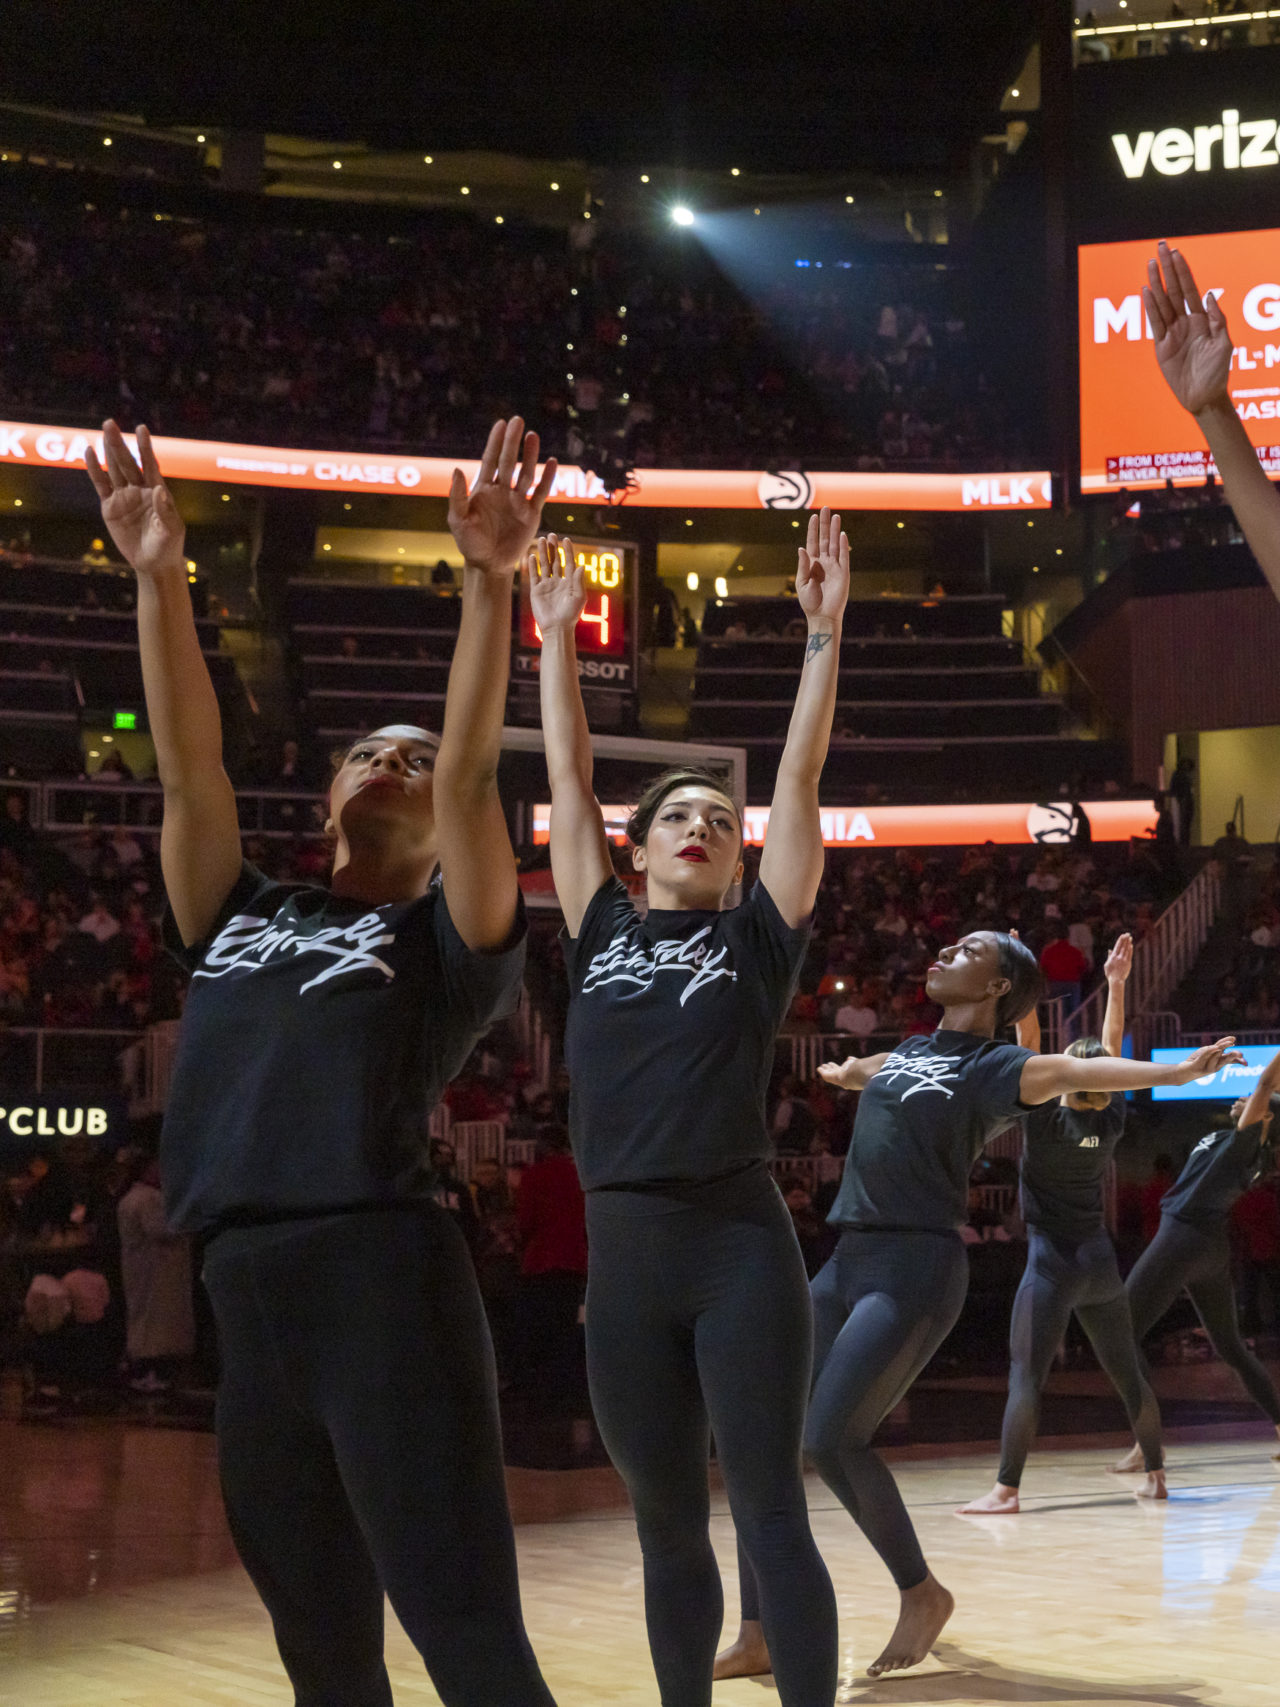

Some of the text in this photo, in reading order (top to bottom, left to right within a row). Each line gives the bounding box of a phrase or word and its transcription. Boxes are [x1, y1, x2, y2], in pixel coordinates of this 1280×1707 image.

[1119, 455, 1152, 468] FROM
[314, 462, 396, 484] CHASE
[1119, 467, 1157, 481] NEVER
[1160, 464, 1205, 477] ENDING
[962, 479, 1033, 505] MLK
